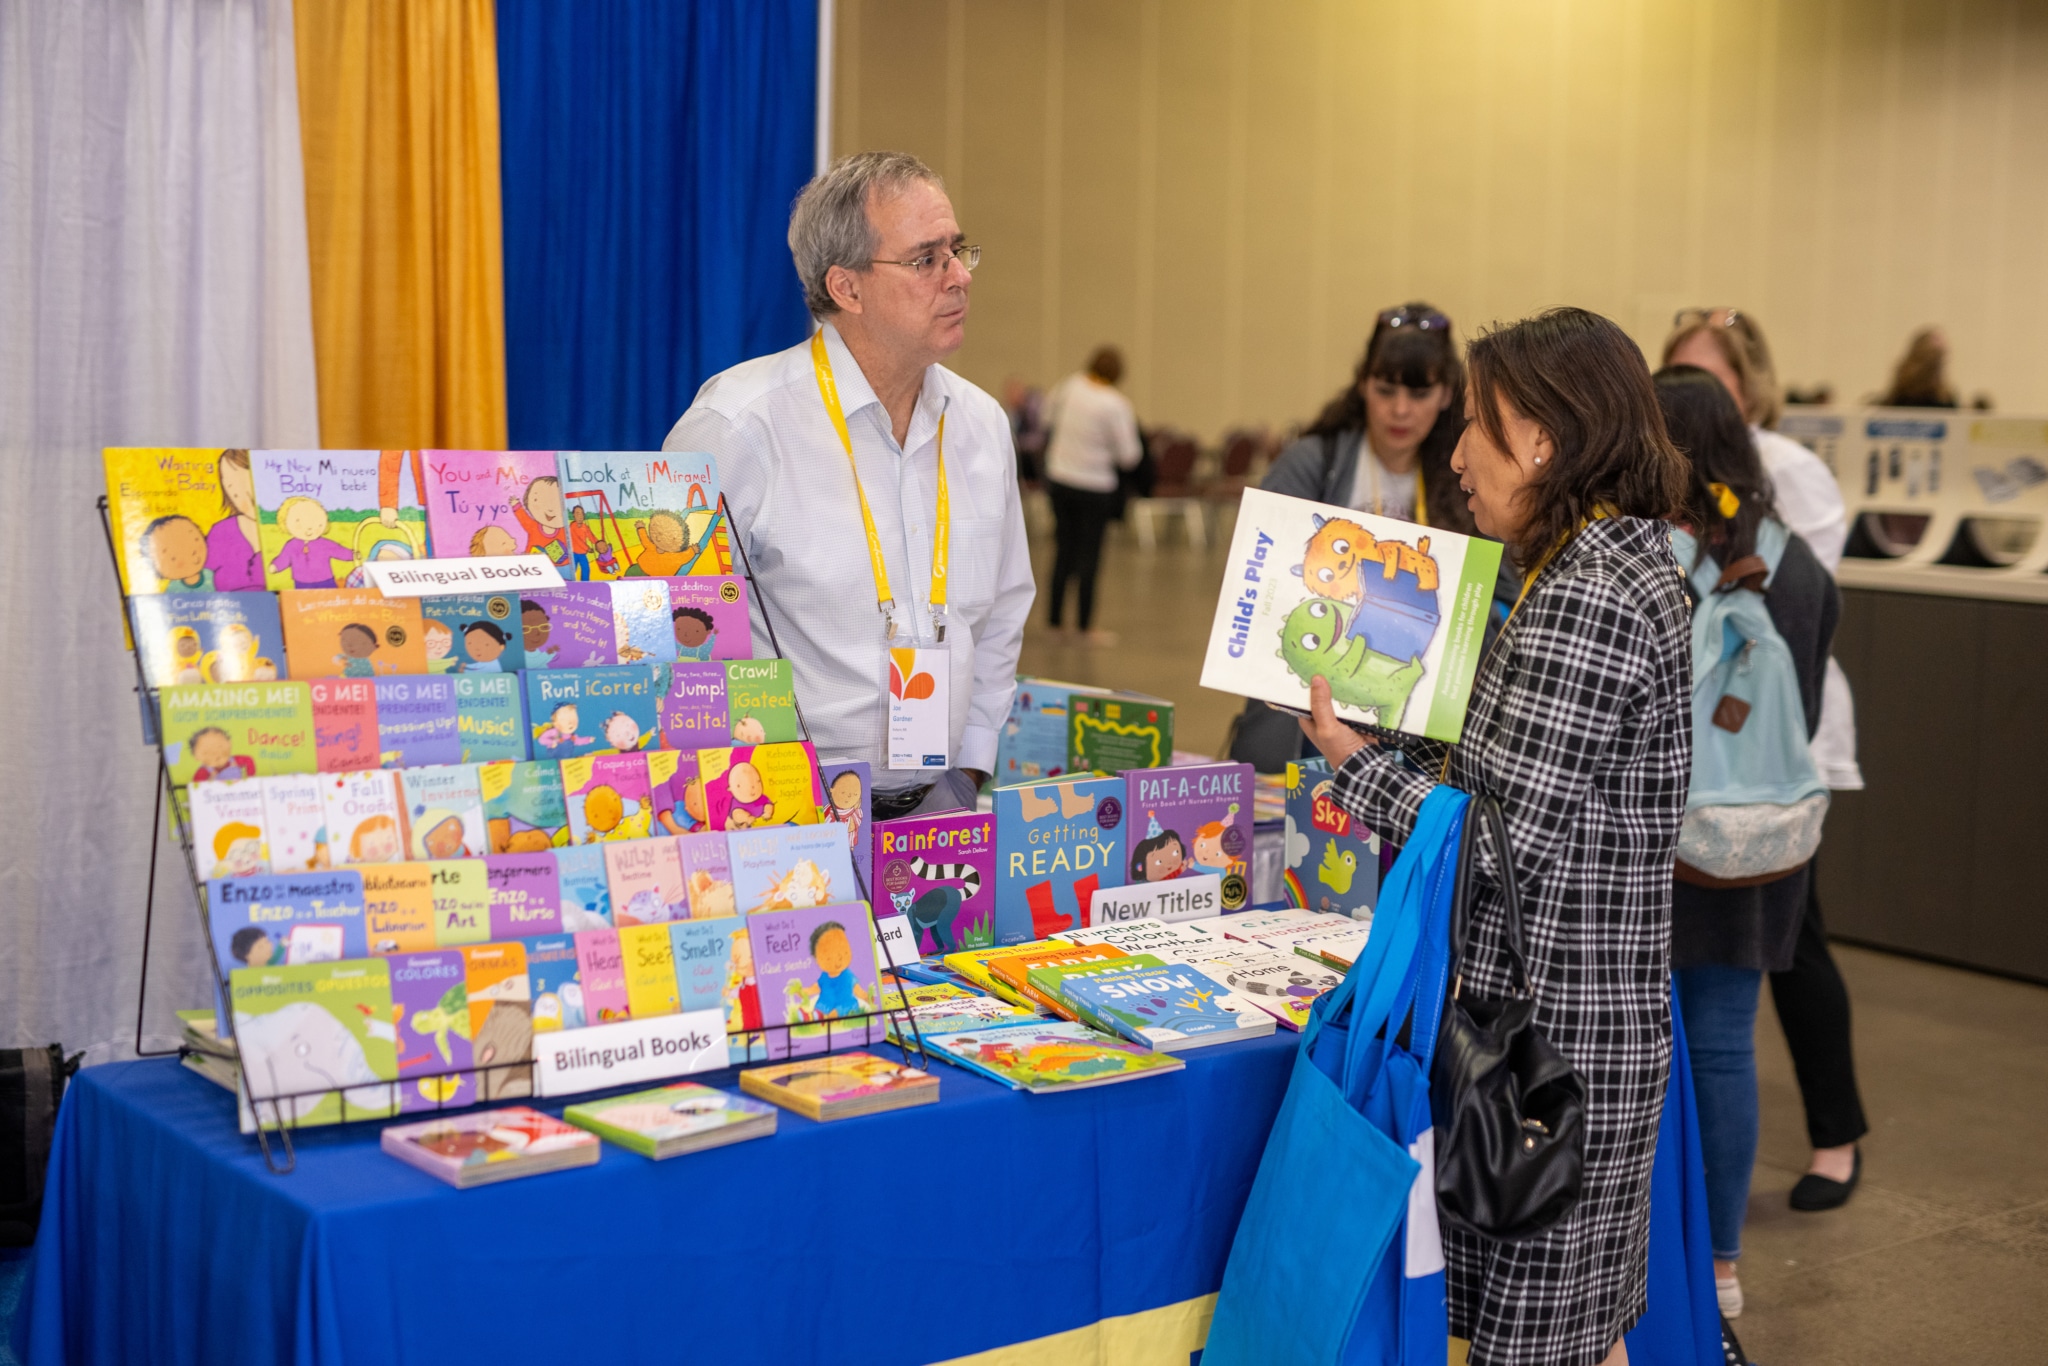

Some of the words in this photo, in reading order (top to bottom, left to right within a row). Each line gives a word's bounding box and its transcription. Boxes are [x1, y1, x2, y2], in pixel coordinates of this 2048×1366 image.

[156, 455, 214, 473] Waiting
[264, 459, 281, 473] My
[287, 459, 312, 473] New
[318, 459, 338, 476] Mi
[342, 467, 376, 476] nuevo
[565, 458, 616, 483] Look
[621, 468, 631, 480] at
[645, 460, 712, 484] ¡Mírame!
[430, 463, 471, 485] You
[476, 469, 491, 480] and
[496, 466, 529, 485] Me
[177, 473, 217, 494] Baby
[279, 474, 322, 497] Baby
[341, 479, 367, 491] bebé
[619, 482, 655, 507] Me!
[445, 490, 469, 513] Tú
[475, 505, 485, 521] y
[490, 505, 509, 521] yo
[388, 567, 478, 585] Bilingual
[480, 564, 543, 580] Books
[681, 580, 714, 592] deditos
[1227, 588, 1257, 658] Child's
[1245, 530, 1274, 582] Play
[1474, 582, 1484, 598] play
[691, 594, 720, 605] Fingers
[1462, 582, 1473, 611] children
[581, 621, 595, 634] You
[586, 611, 610, 629] Happy
[575, 632, 596, 645] Know
[728, 661, 778, 680] Crawl!
[335, 684, 369, 702] ME!
[416, 683, 448, 700] ME!
[480, 678, 512, 695] ME!
[541, 680, 580, 701] Run!
[585, 677, 648, 697] ¡Corre!
[674, 678, 725, 703] Jump!
[168, 687, 259, 708] AMAZING
[266, 687, 300, 706] ME!
[733, 690, 792, 709] ¡Gatea!
[670, 710, 727, 731] ¡Salta!
[248, 728, 305, 746] Dance!
[766, 748, 796, 758] Rebote
[596, 759, 625, 773] Toque
[351, 779, 385, 798] Fall
[407, 775, 456, 789] Winter
[769, 777, 799, 786] Bounce
[1140, 773, 1242, 801] PAT-A-CAKE
[269, 784, 317, 803] Spring
[421, 787, 480, 803] Invierno
[779, 788, 802, 800] Jiggle
[1160, 800, 1176, 808] Book
[1178, 799, 1186, 807] of
[1188, 797, 1214, 806] Nursery
[1315, 800, 1347, 832] Sky
[883, 822, 991, 854] Rainforest
[1028, 823, 1100, 846] Getting
[615, 845, 655, 871] WILD!
[743, 860, 776, 870] Playtime
[1009, 841, 1116, 878] READY
[222, 883, 273, 903] Enzo
[288, 878, 355, 898] maestro
[488, 888, 528, 905] Enzo
[249, 903, 294, 922] Enzo
[510, 904, 555, 921] Nurse
[1101, 900, 1151, 923] New
[1157, 888, 1213, 915] Titles
[446, 912, 477, 929] Art
[765, 933, 801, 954] Feel?
[1104, 929, 1178, 945] Colors
[637, 945, 673, 968] See?
[680, 938, 724, 962] Smell?
[1019, 953, 1057, 963] Making
[1056, 949, 1092, 957] Tracks
[586, 950, 622, 972] Hear
[1058, 964, 1100, 974] Making
[1099, 959, 1134, 967] Tracks
[395, 965, 459, 982] COLORES
[1093, 974, 1135, 983] Making
[1133, 968, 1169, 978] Tracks
[1233, 965, 1291, 978] Home
[236, 980, 313, 999] OPPOSITES
[315, 975, 389, 993] OPUESTOS
[1024, 986, 1039, 1000] FARM
[1099, 974, 1195, 999] SNOW
[1064, 997, 1078, 1012] PARK
[1097, 1009, 1114, 1025] SNOW
[555, 1038, 645, 1072] Bilingual
[651, 1031, 712, 1057] Books
